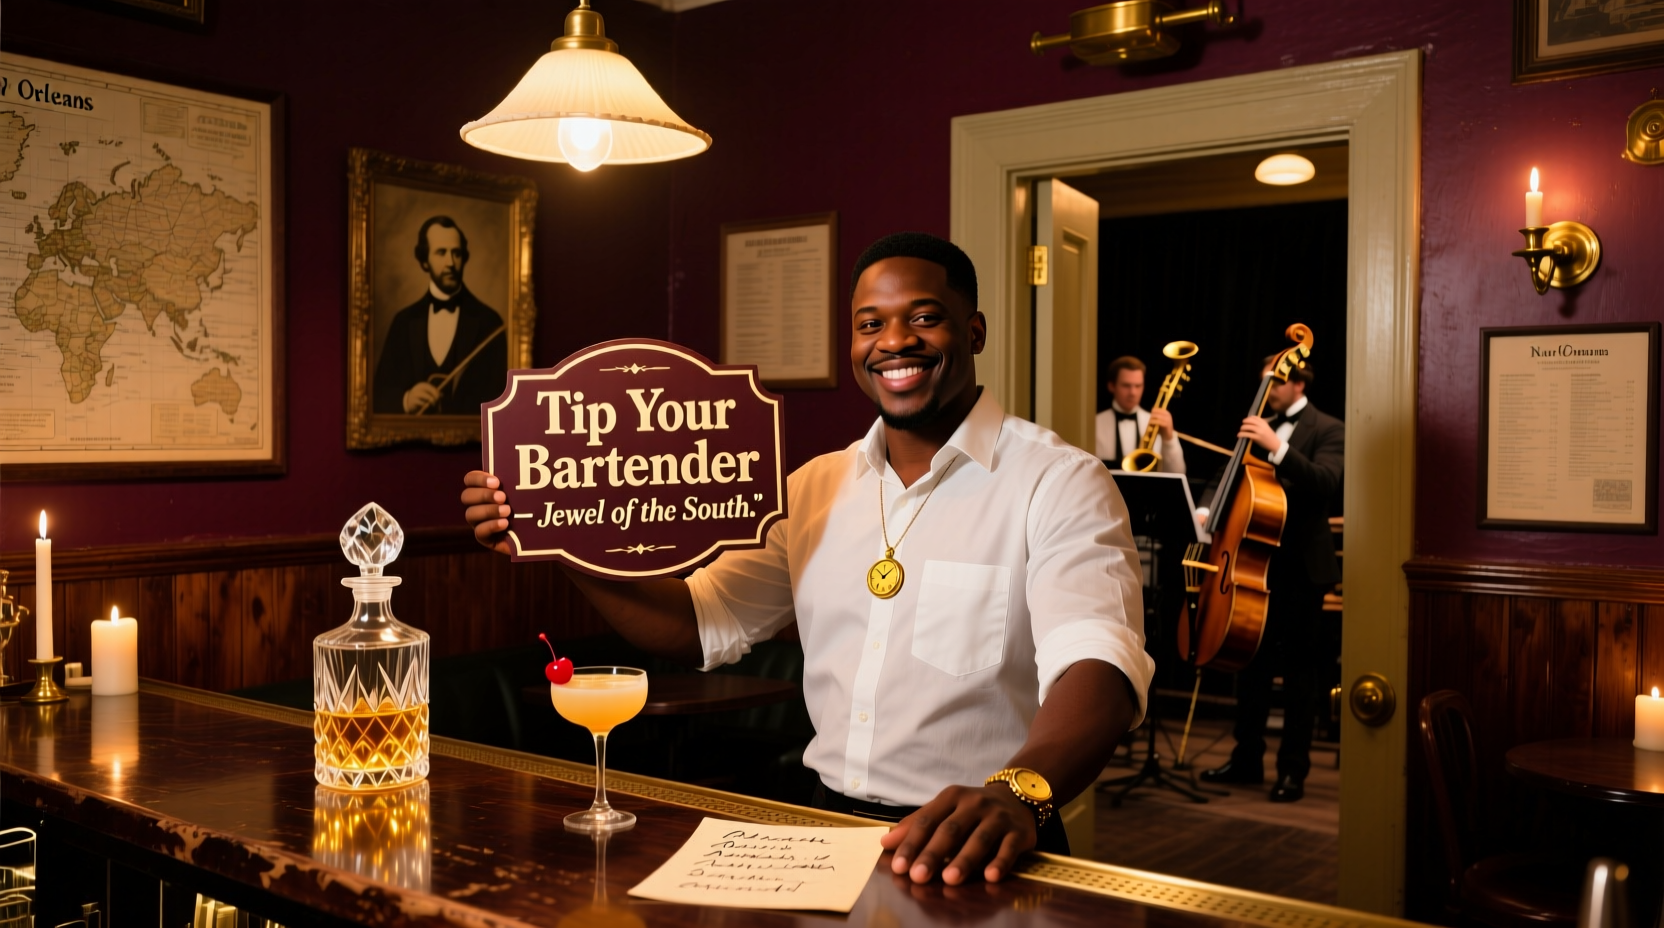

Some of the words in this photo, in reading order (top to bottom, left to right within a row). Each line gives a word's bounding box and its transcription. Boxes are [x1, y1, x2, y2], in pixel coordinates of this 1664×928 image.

[17, 78, 94, 111] Orleans
[536, 390, 617, 447] Tip
[625, 387, 737, 432] Your
[514, 438, 761, 491] Bartender
[536, 498, 606, 528] Jewel
[610, 497, 640, 531] of
[640, 497, 677, 523] the
